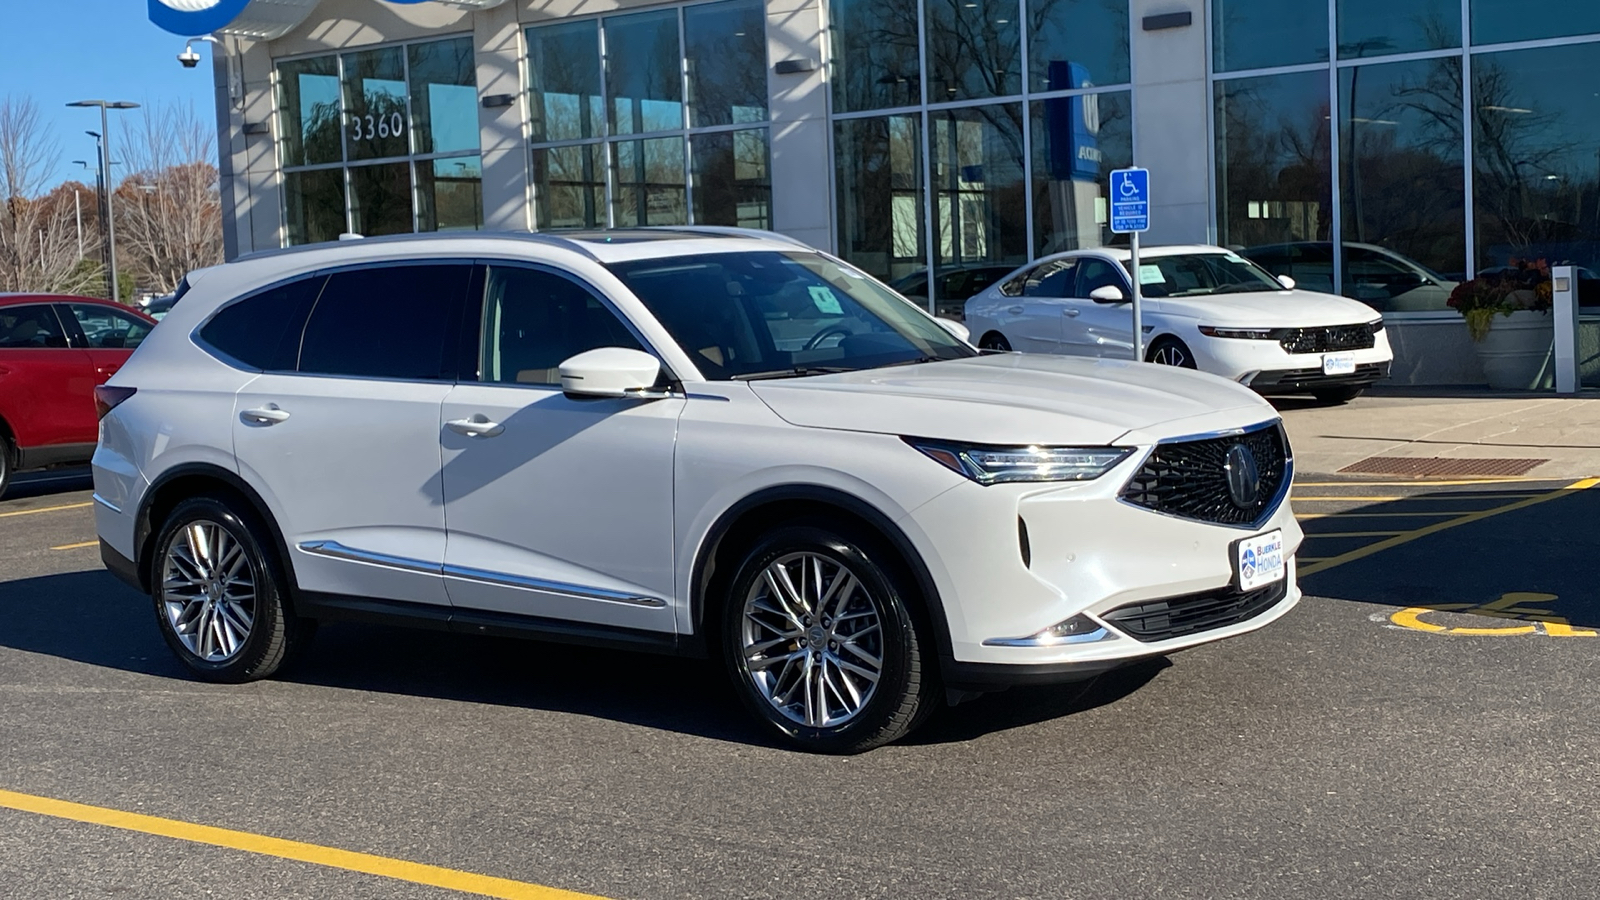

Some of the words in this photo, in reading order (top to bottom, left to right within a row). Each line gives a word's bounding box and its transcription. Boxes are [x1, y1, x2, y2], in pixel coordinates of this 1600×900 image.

[352, 112, 402, 141] 3360
[1257, 541, 1281, 556] BUERKLE
[1257, 554, 1282, 573] HONDA
